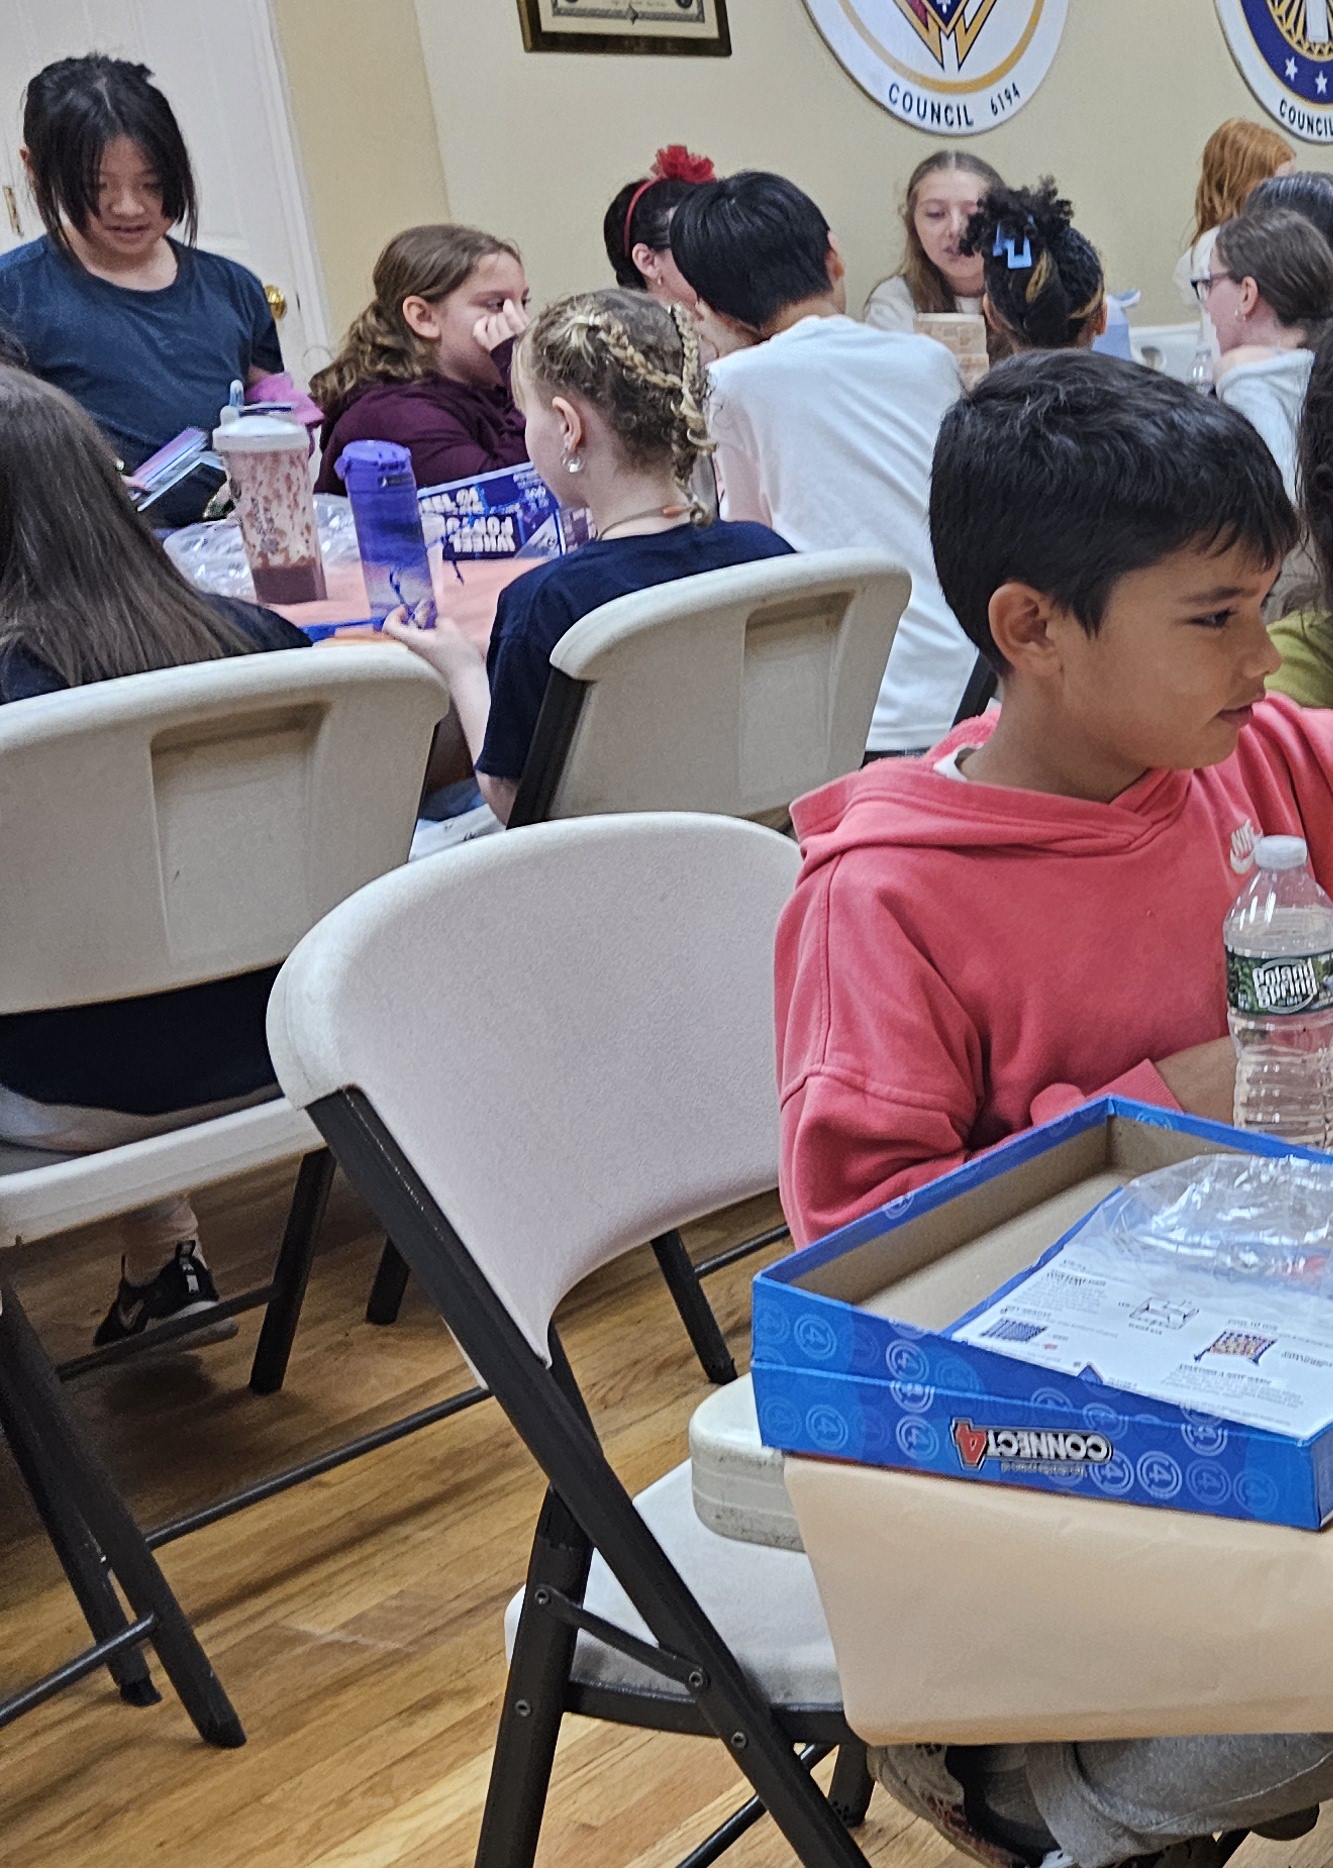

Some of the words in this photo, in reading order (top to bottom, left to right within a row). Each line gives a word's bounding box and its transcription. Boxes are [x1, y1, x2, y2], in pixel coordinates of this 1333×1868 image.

[888, 83, 975, 128] COUNCIL
[990, 82, 1021, 116] 6194
[449, 534, 516, 553] WHEEL
[1252, 958, 1316, 988] Poland
[953, 1420, 987, 1467] 4
[987, 1429, 1108, 1460] CONNECT
